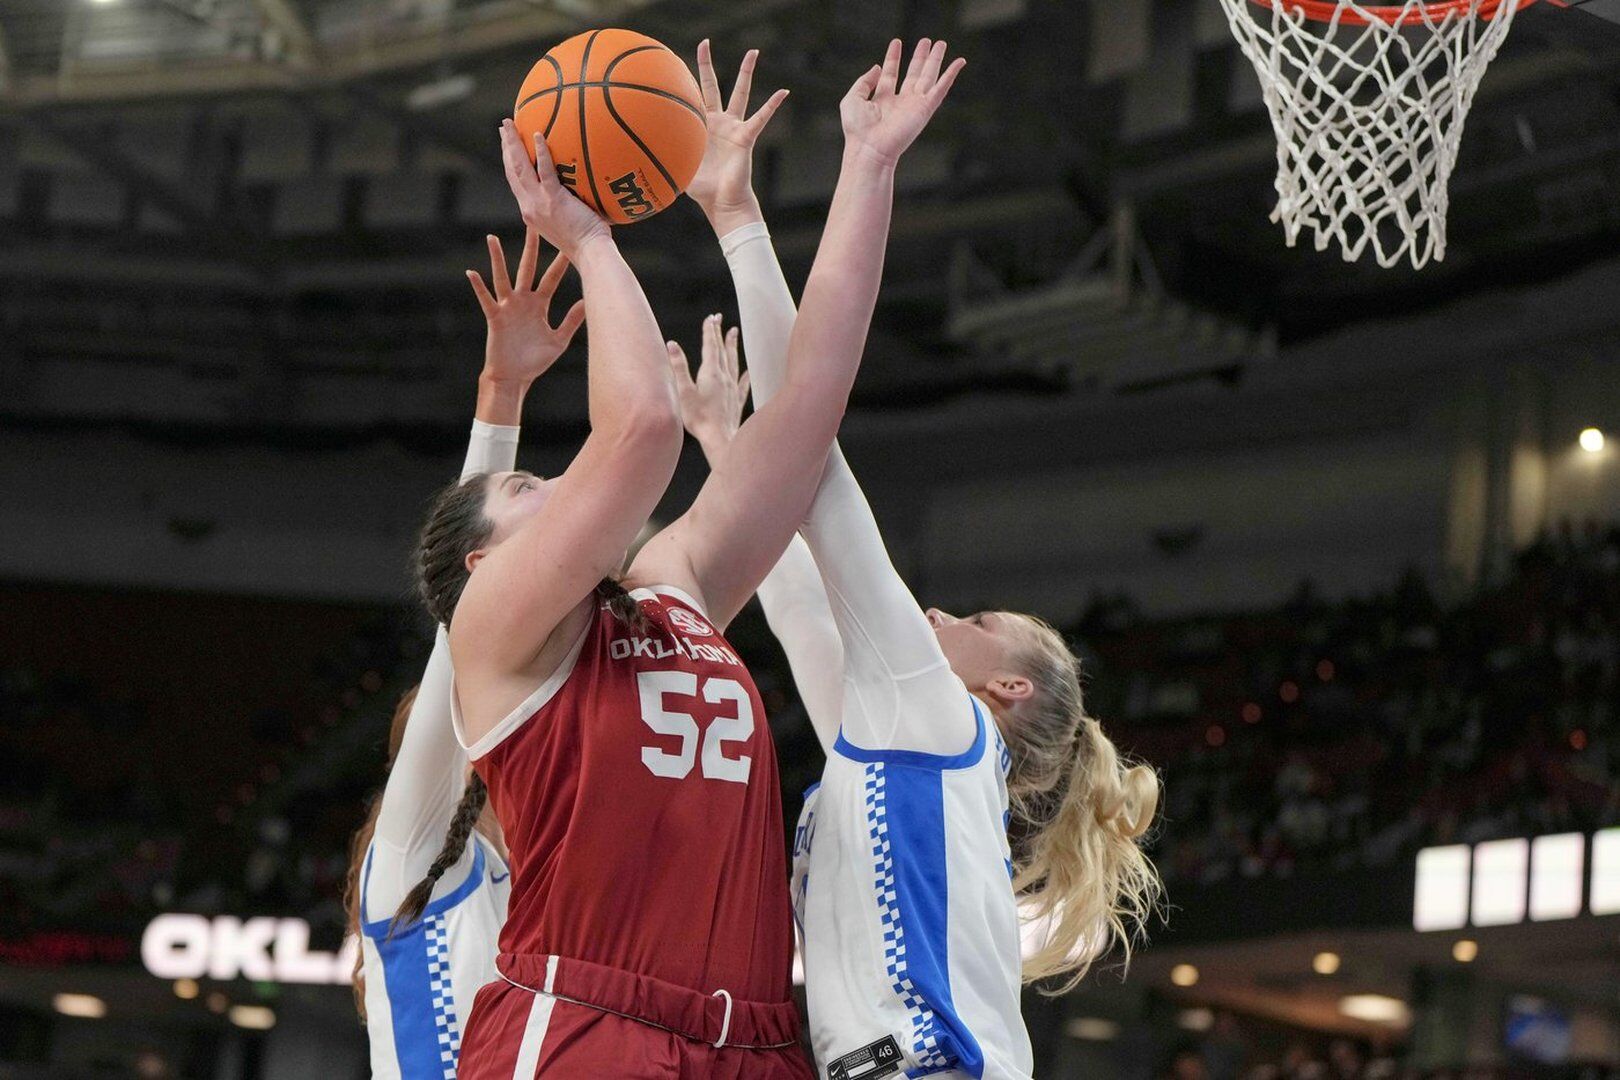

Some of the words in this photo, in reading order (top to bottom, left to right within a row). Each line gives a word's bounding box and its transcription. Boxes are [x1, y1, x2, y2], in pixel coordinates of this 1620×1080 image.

[608, 171, 656, 220] CAA
[637, 670, 755, 784] 52
[878, 1044, 894, 1059] 46
